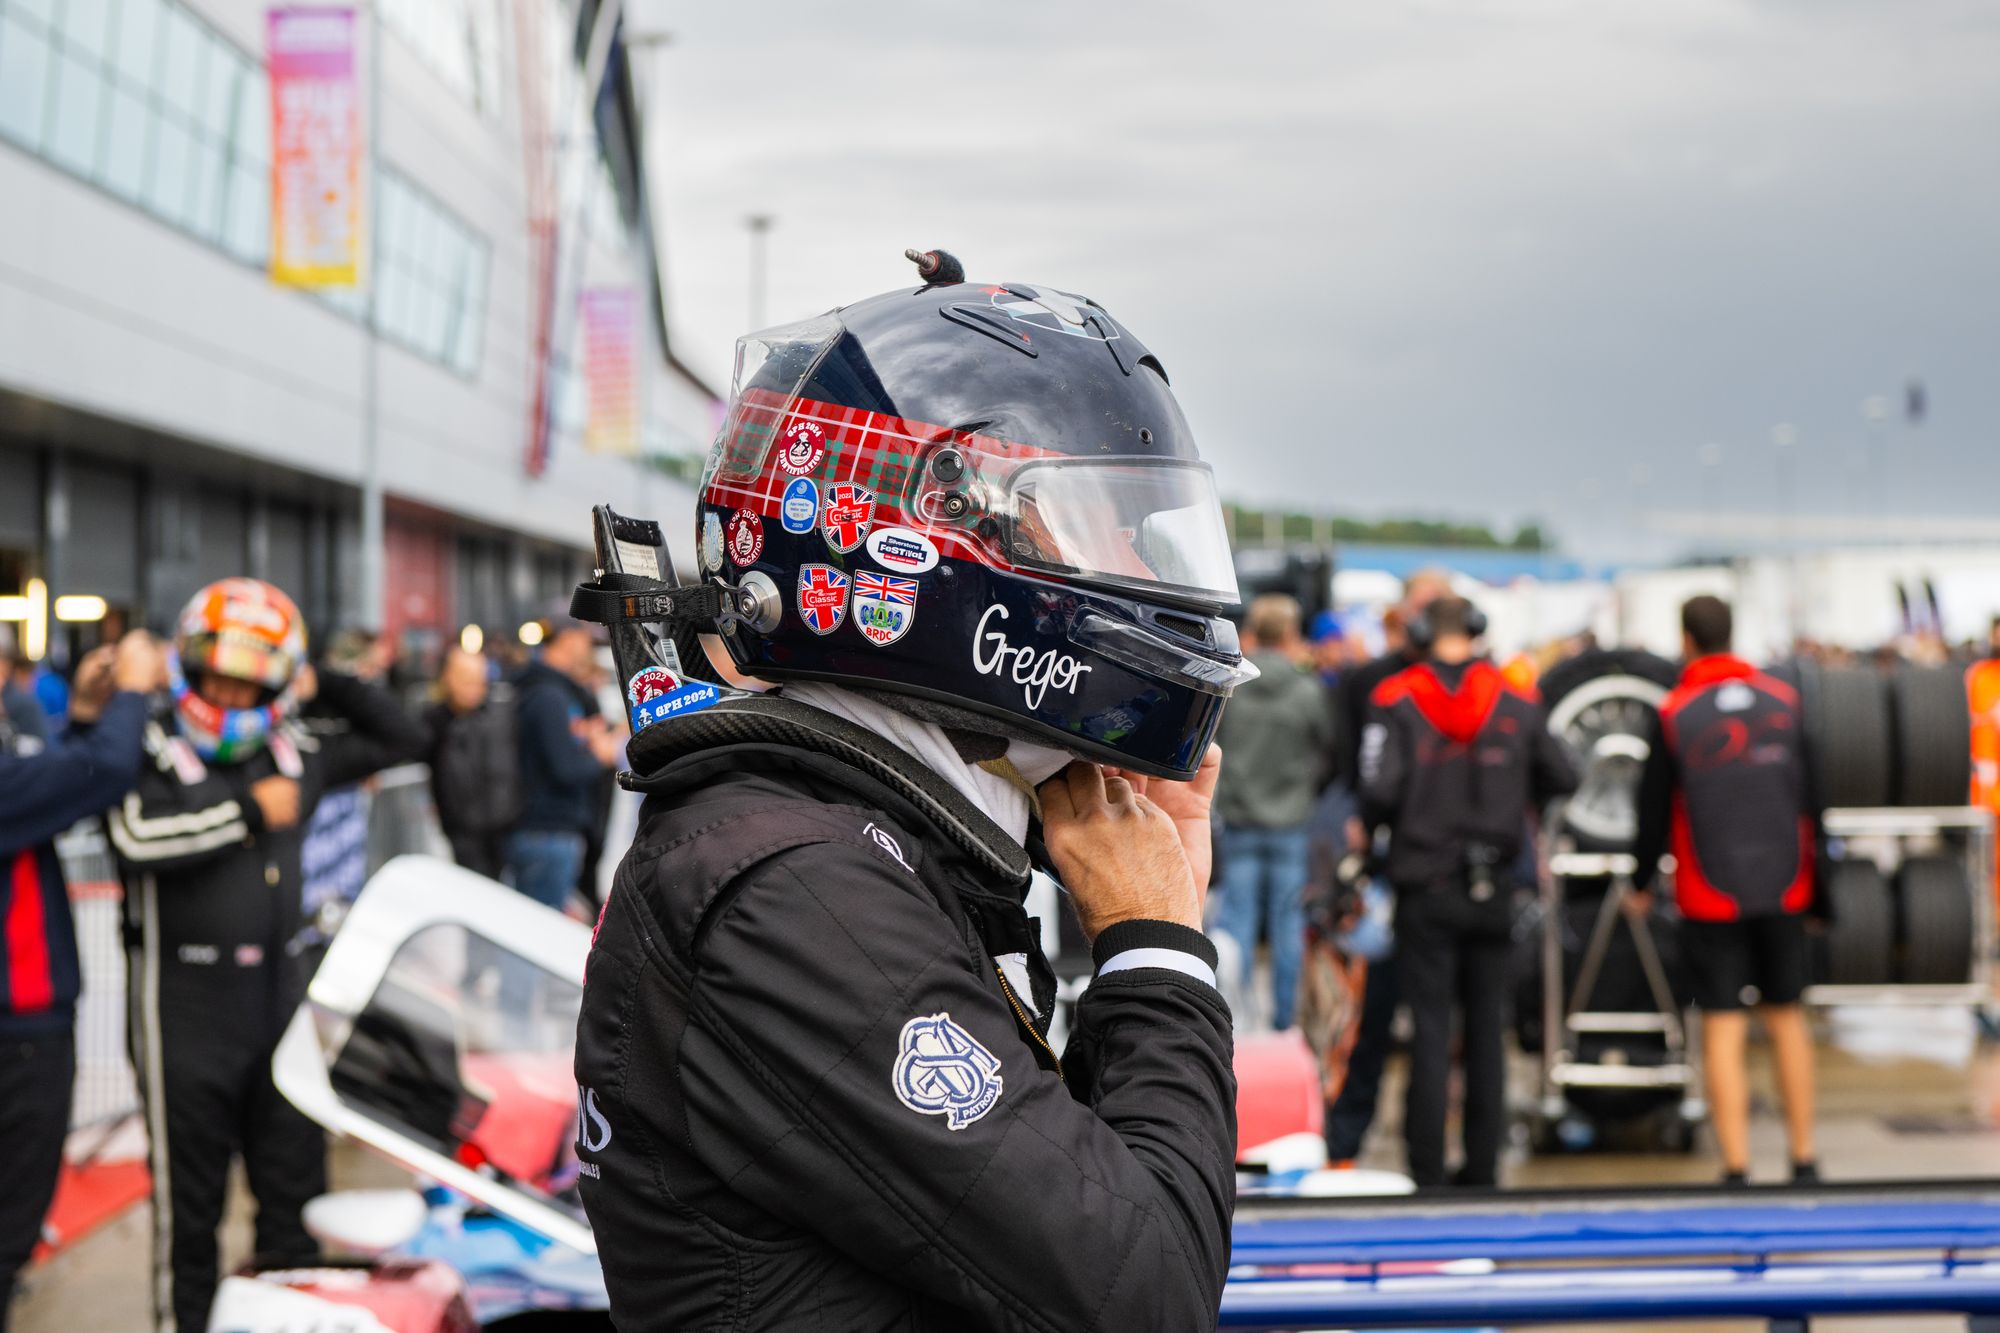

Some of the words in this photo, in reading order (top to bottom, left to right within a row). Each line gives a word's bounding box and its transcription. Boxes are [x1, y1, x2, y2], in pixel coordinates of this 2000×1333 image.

[806, 422, 822, 437] 2024
[779, 449, 823, 475] IDENTIFICATION
[742, 509, 758, 526] 2022
[888, 538, 920, 550] Silverstone
[809, 595, 838, 604] Classic
[866, 627, 892, 641] BRDC
[972, 603, 1092, 710] Gregor
[644, 672, 667, 683] 2022
[655, 698, 683, 717] GPH
[684, 687, 714, 705] 2024
[962, 1089, 995, 1119] PATRON
